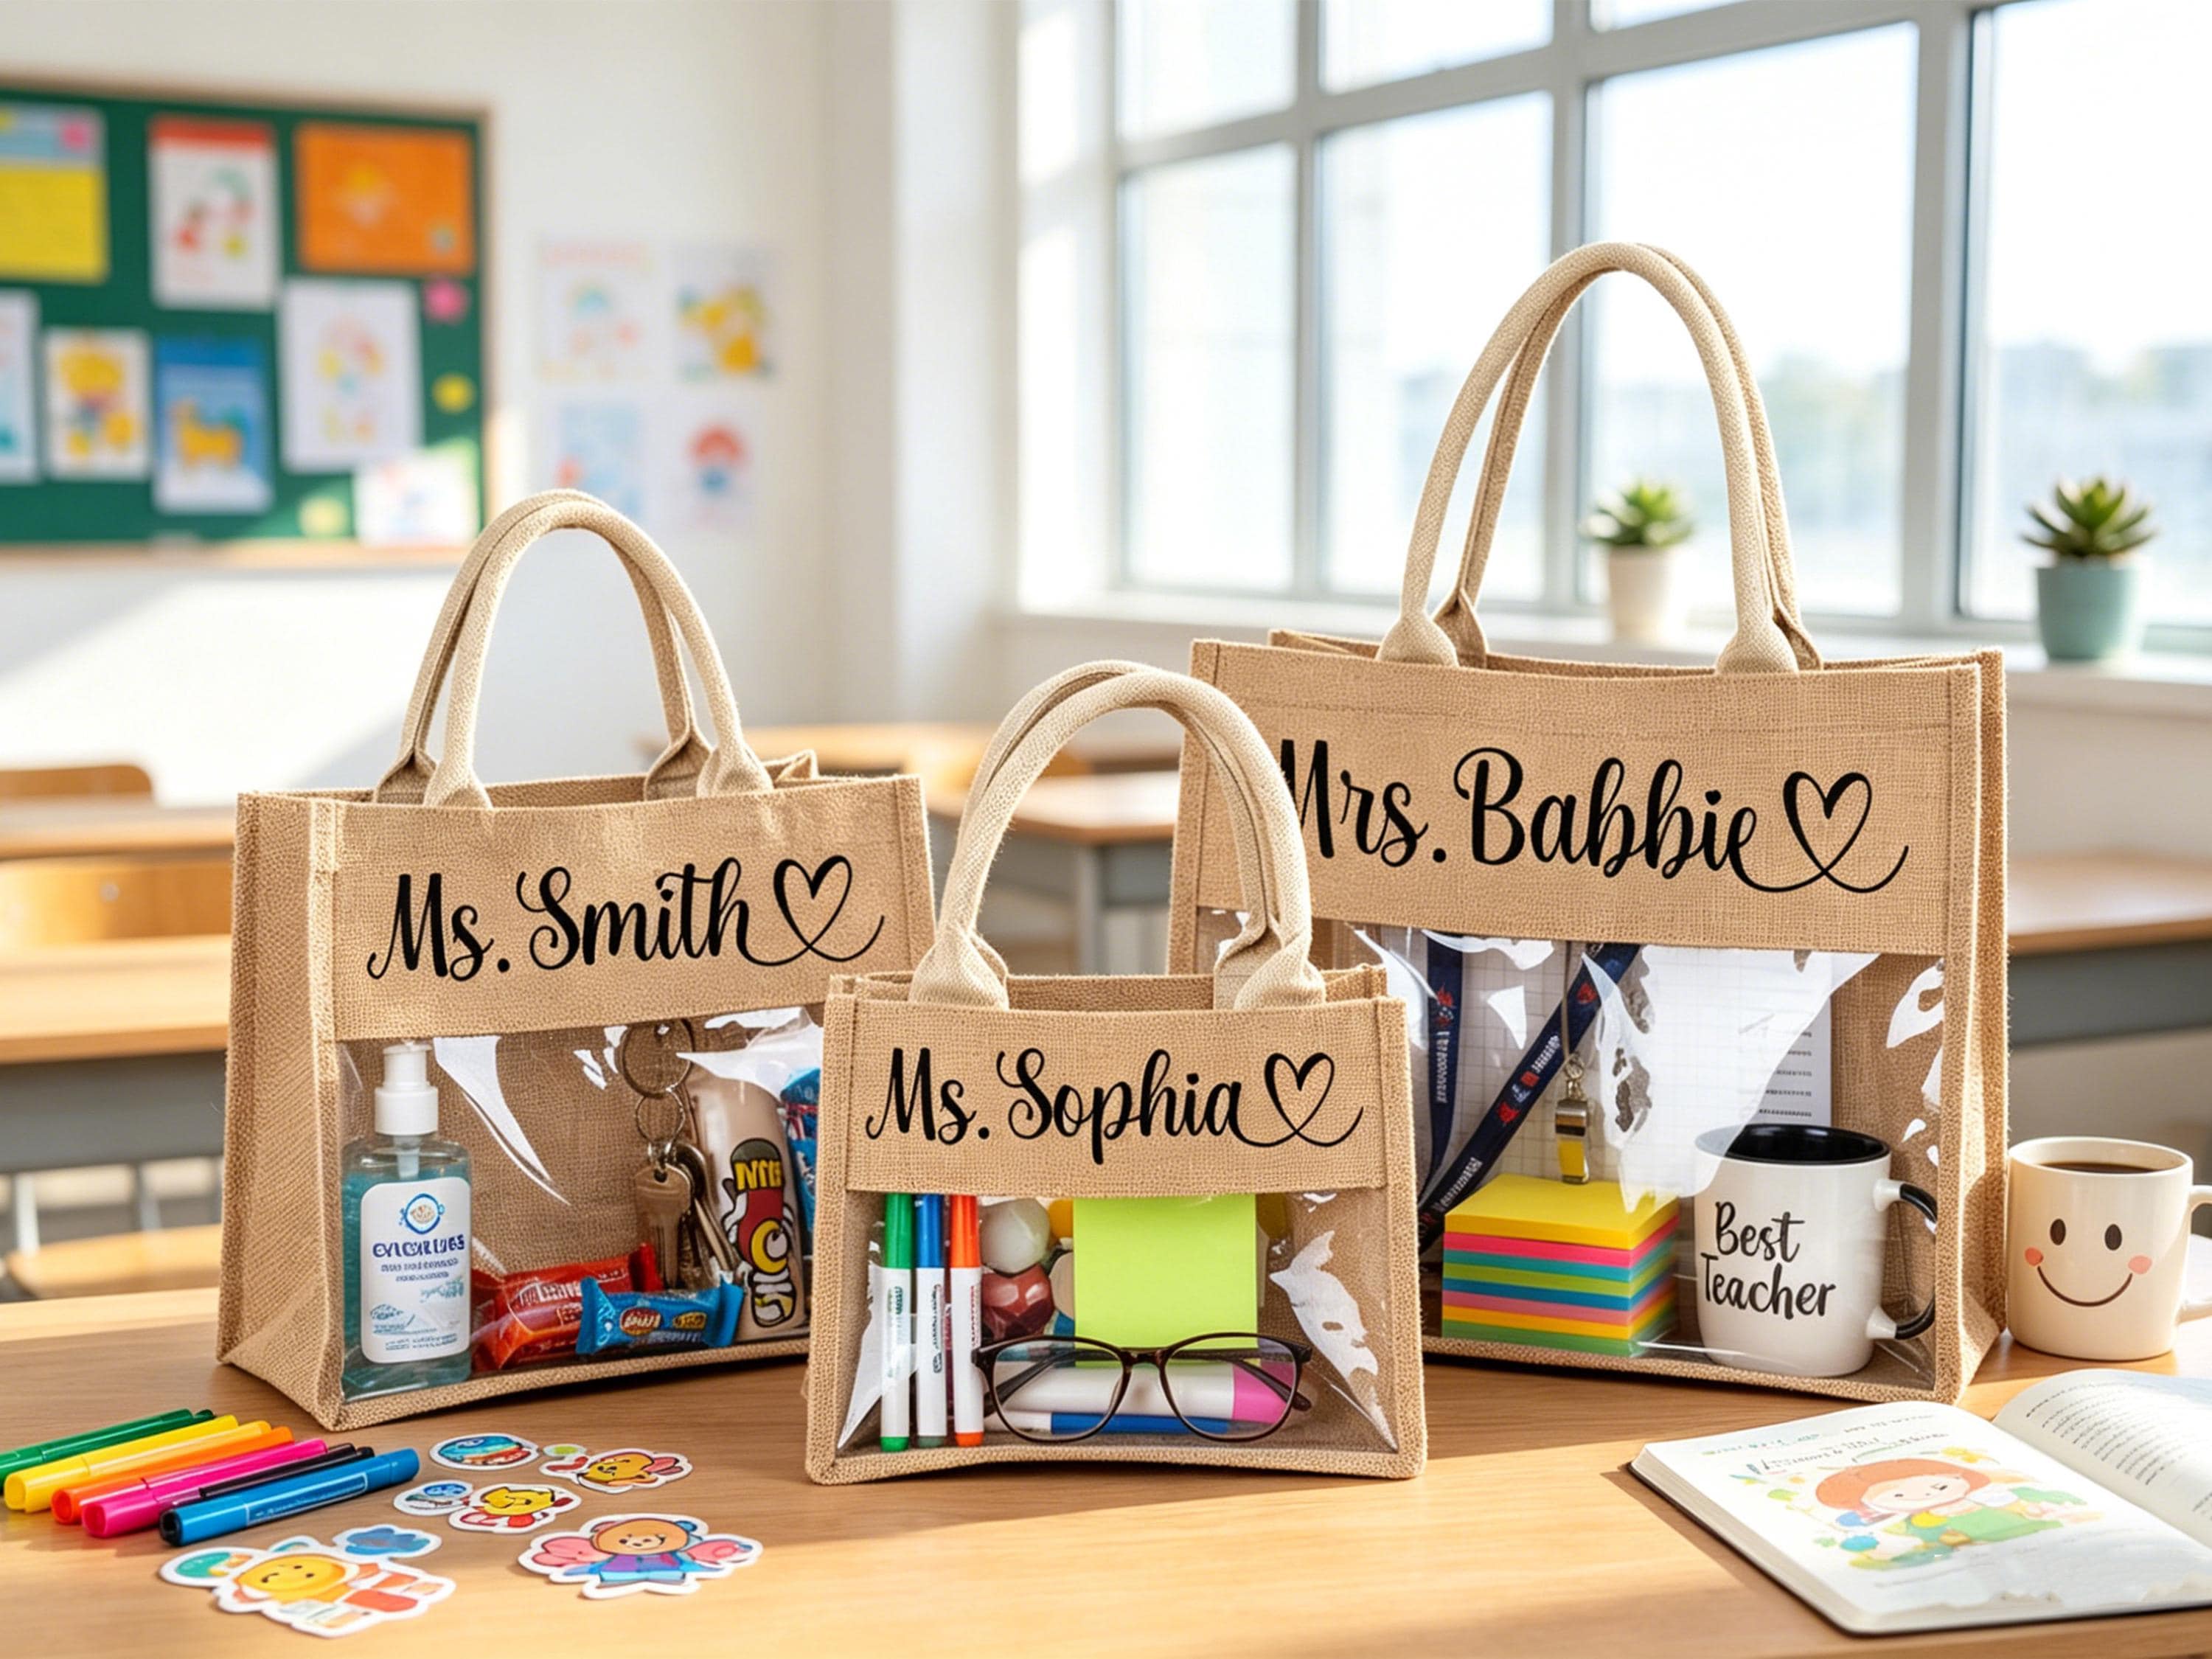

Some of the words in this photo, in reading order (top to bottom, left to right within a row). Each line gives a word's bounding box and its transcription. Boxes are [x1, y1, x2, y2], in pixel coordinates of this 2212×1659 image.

[1281, 739, 1447, 868] Mrs.
[1453, 747, 1759, 891] Babbie
[366, 872, 510, 982] Ms.
[516, 857, 754, 970] Smith
[866, 1047, 990, 1145] Ms.
[996, 1047, 1246, 1165] Sophia
[1700, 1252, 1837, 1321] Teacher
[1715, 1201, 1805, 1263] Best
